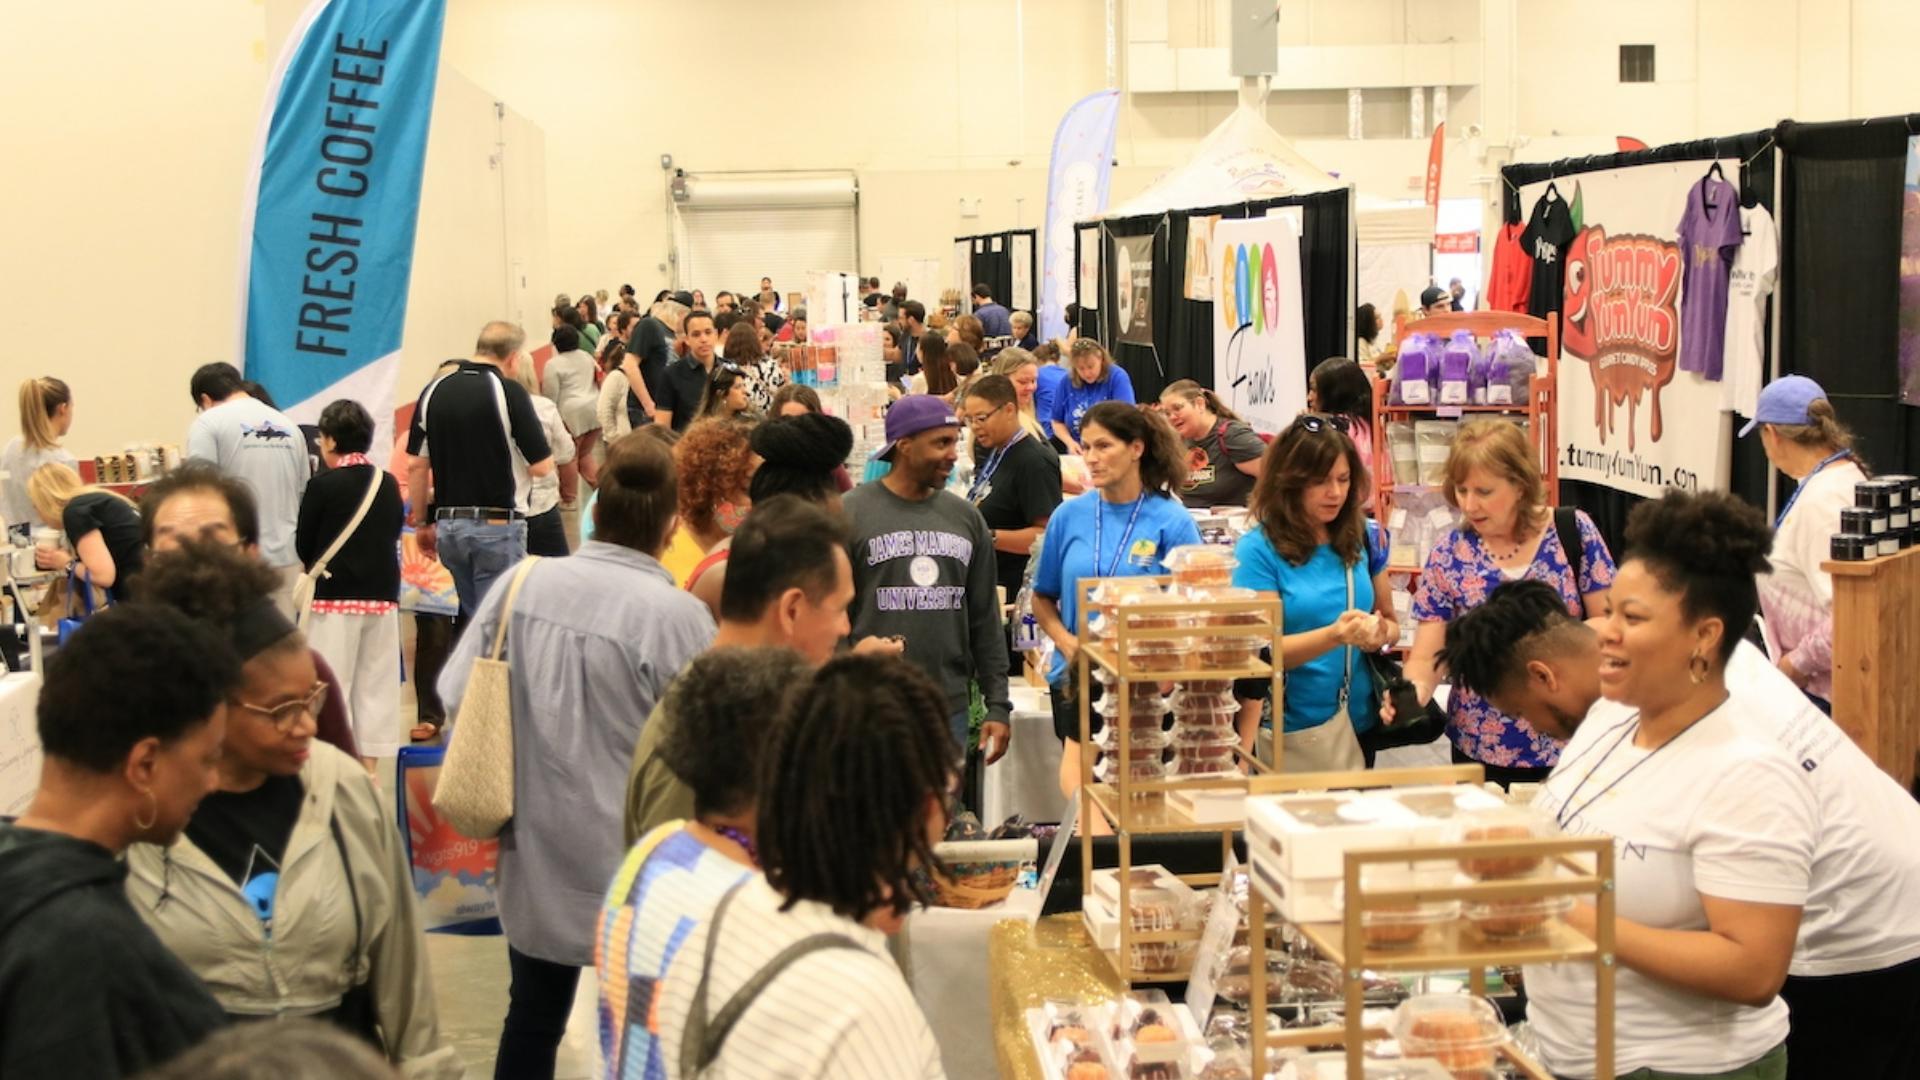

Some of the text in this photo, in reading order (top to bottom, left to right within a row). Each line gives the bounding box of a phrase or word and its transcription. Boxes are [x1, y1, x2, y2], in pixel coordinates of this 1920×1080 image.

[295, 32, 389, 357] FRESH COFFEE
[1586, 237, 1679, 309] Tummy
[867, 531, 915, 566] JAMES
[876, 586, 966, 611] UNIVERSITY
